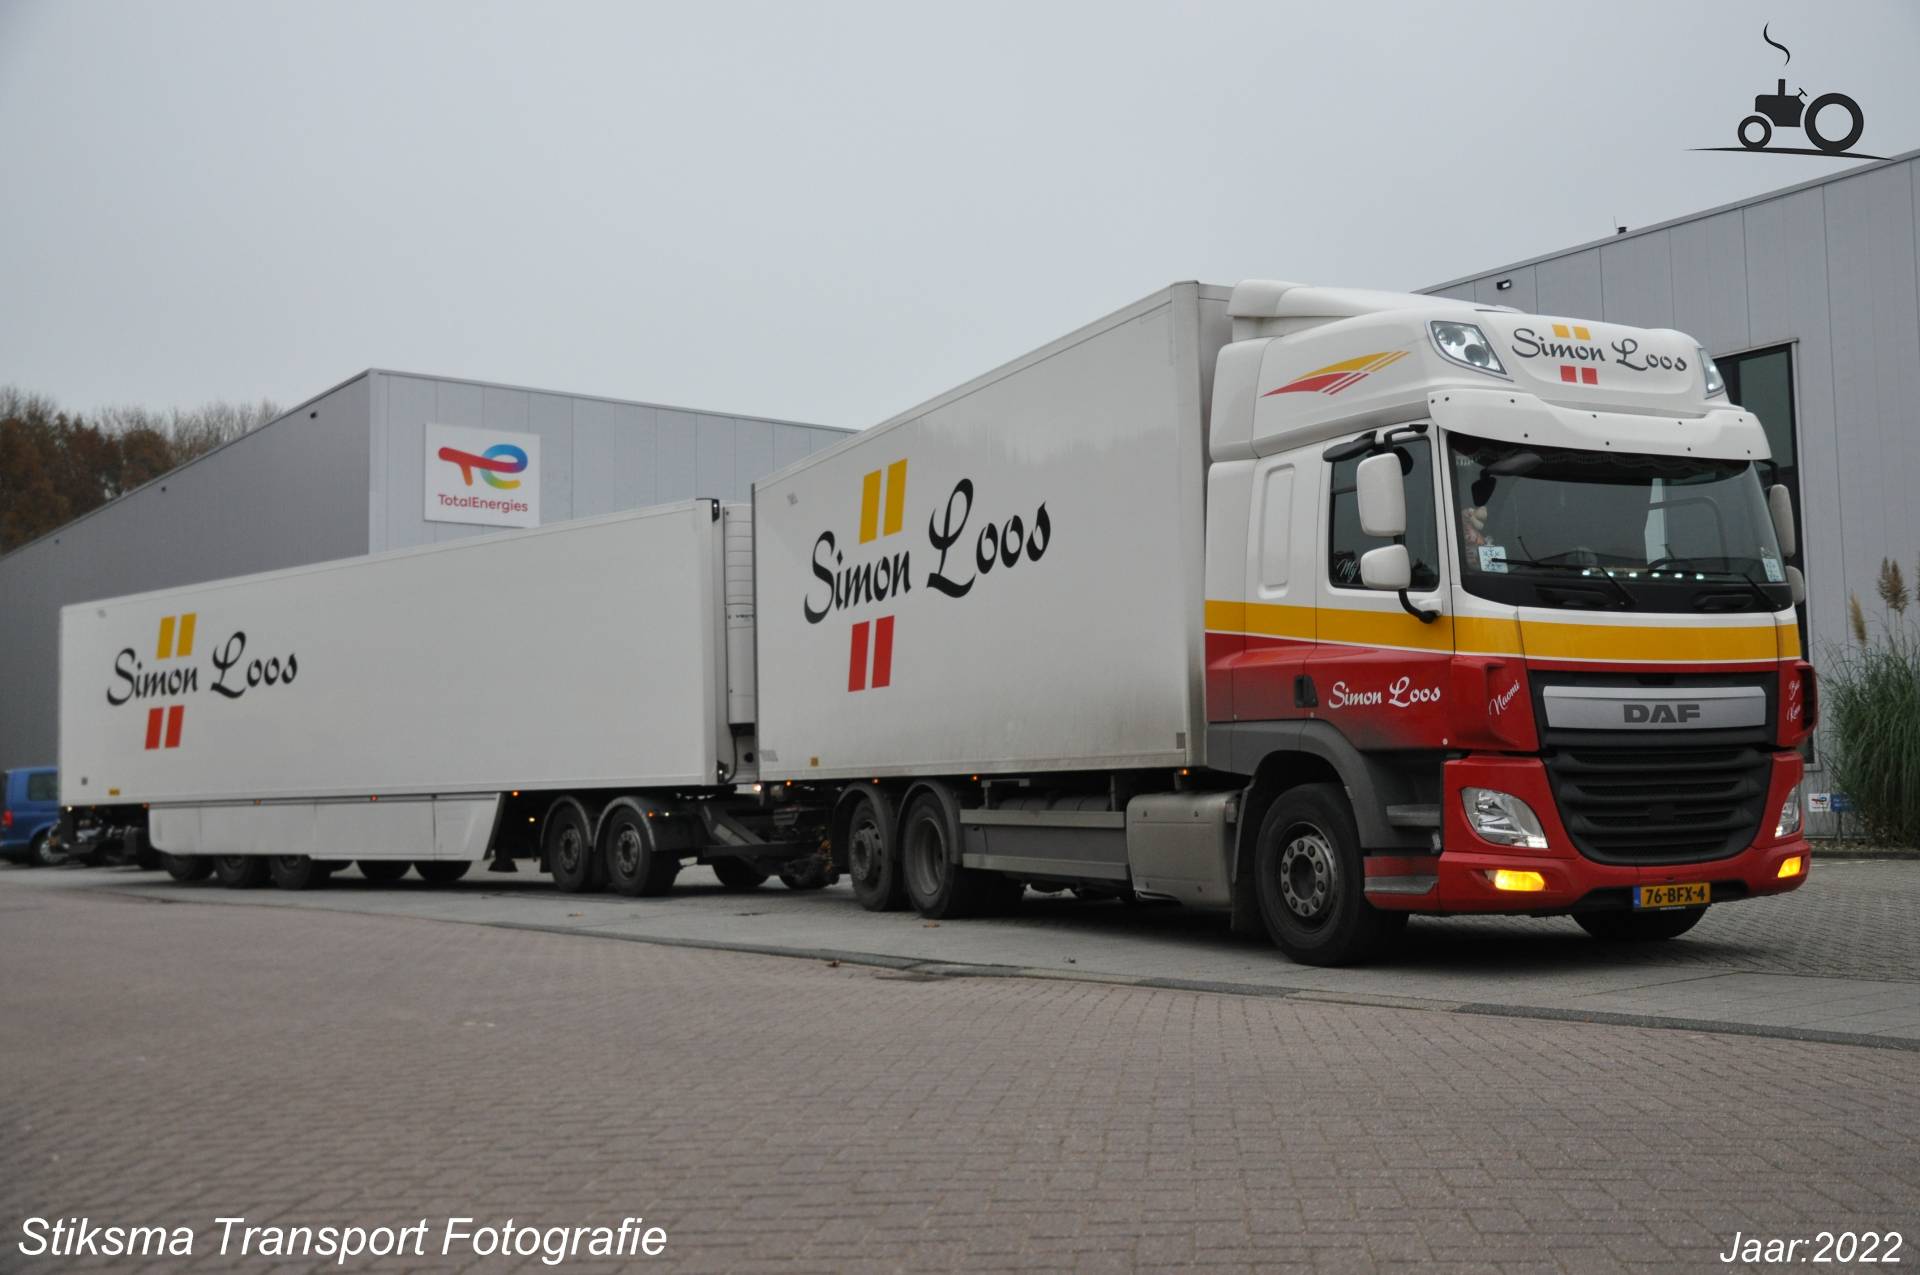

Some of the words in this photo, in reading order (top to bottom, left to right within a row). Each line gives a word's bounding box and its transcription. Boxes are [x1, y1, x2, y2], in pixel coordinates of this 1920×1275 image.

[1512, 328, 1606, 362] Simon
[1611, 338, 1687, 372] Loos
[438, 493, 528, 513] TotalEnergies
[804, 530, 911, 624] Simon
[926, 478, 1051, 598] Loos
[106, 647, 198, 706] Simon
[210, 631, 298, 699] Loos
[1328, 681, 1382, 709] Simon
[1388, 676, 1441, 708] Loos
[1623, 704, 1700, 723] DAF
[1645, 885, 1706, 905] 76-BFX-4
